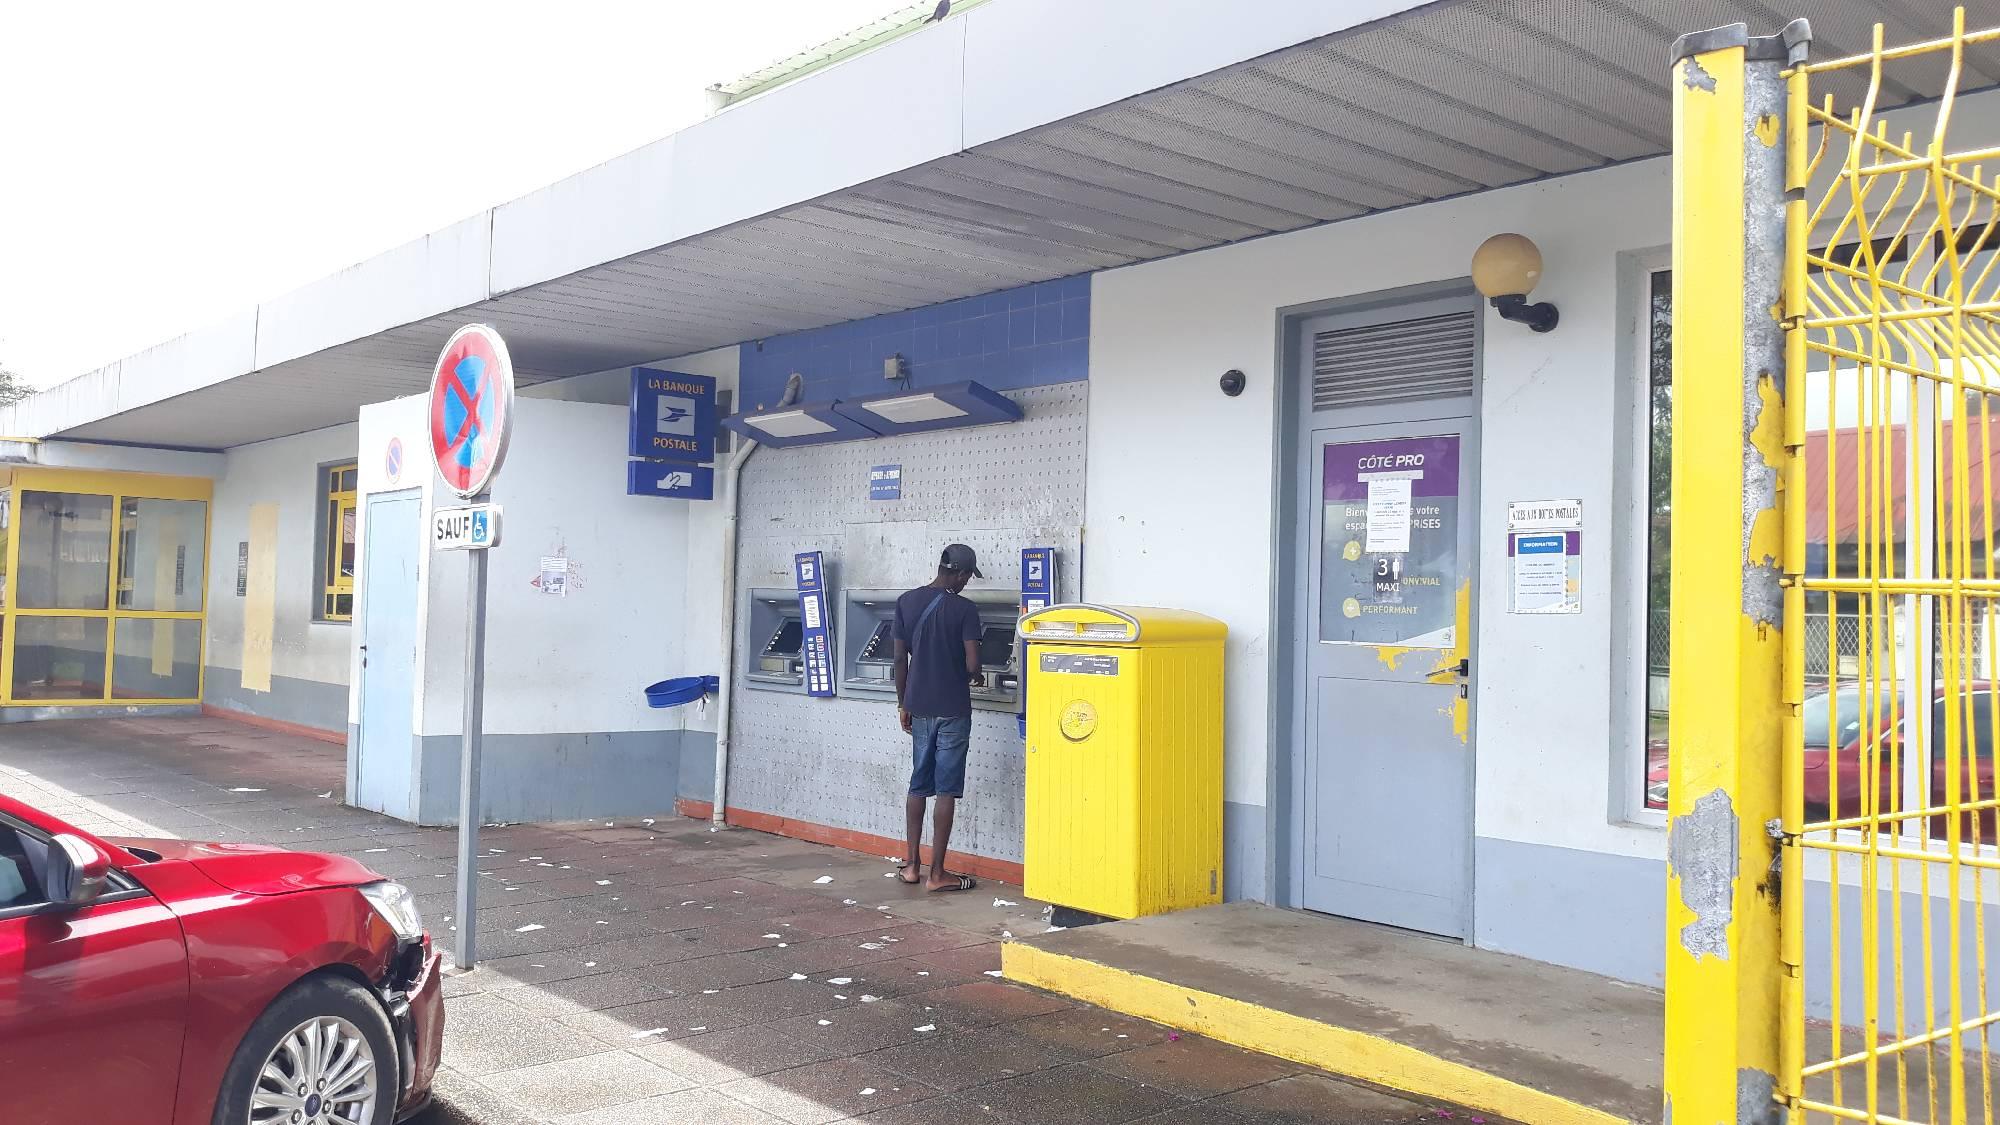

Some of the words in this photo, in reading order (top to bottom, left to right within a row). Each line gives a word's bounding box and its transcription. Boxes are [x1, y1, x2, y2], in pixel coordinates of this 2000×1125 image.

[648, 378, 660, 389] LA
[664, 380, 705, 395] BANQUE
[653, 437, 698, 451] POSTALE
[1358, 453, 1394, 470] CÔTÉ
[1395, 454, 1425, 467] PRO
[1416, 505, 1440, 515] votre
[437, 516, 470, 541] SAUF
[1377, 558, 1388, 576] 3
[1376, 582, 1400, 592] MAXI
[1362, 605, 1419, 615] PERFORMANT
